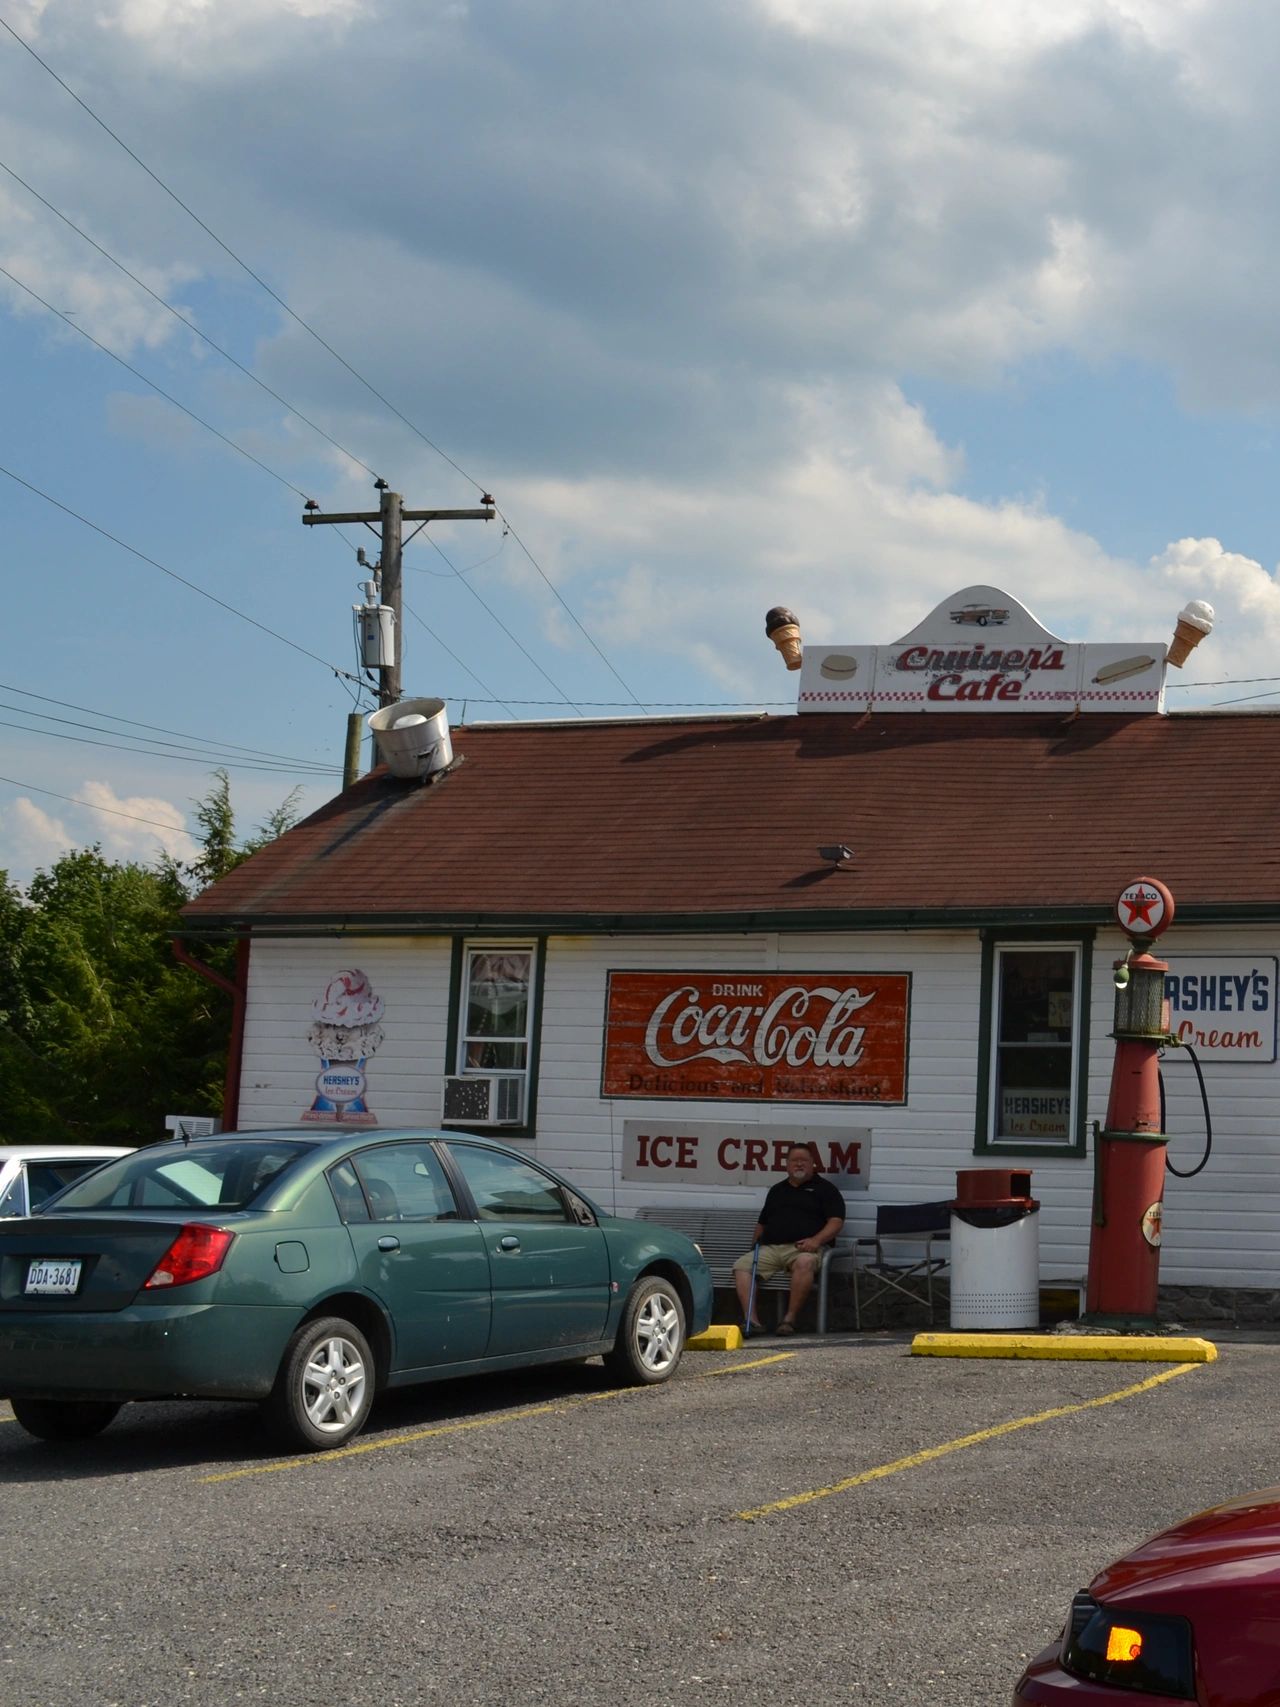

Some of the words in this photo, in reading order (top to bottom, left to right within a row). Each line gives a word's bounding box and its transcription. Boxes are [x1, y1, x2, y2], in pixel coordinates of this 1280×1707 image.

[895, 643, 1065, 672] Cruiser's
[1124, 892, 1158, 901] TEXACO
[711, 983, 764, 998] DRINK
[1164, 968, 1270, 1012] RSHEY'S
[644, 985, 878, 1069] Coca-Cola
[1177, 1020, 1263, 1048] Cream
[323, 1076, 360, 1086] HERSHEY'S
[628, 1074, 721, 1092] Delicious
[730, 1081, 764, 1096] and
[1010, 1119, 1026, 1132] Ice
[1029, 1119, 1067, 1133] Cream
[636, 1135, 699, 1169] ICE
[717, 1138, 862, 1175] CREAM
[30, 1268, 77, 1286] DDA-3681
